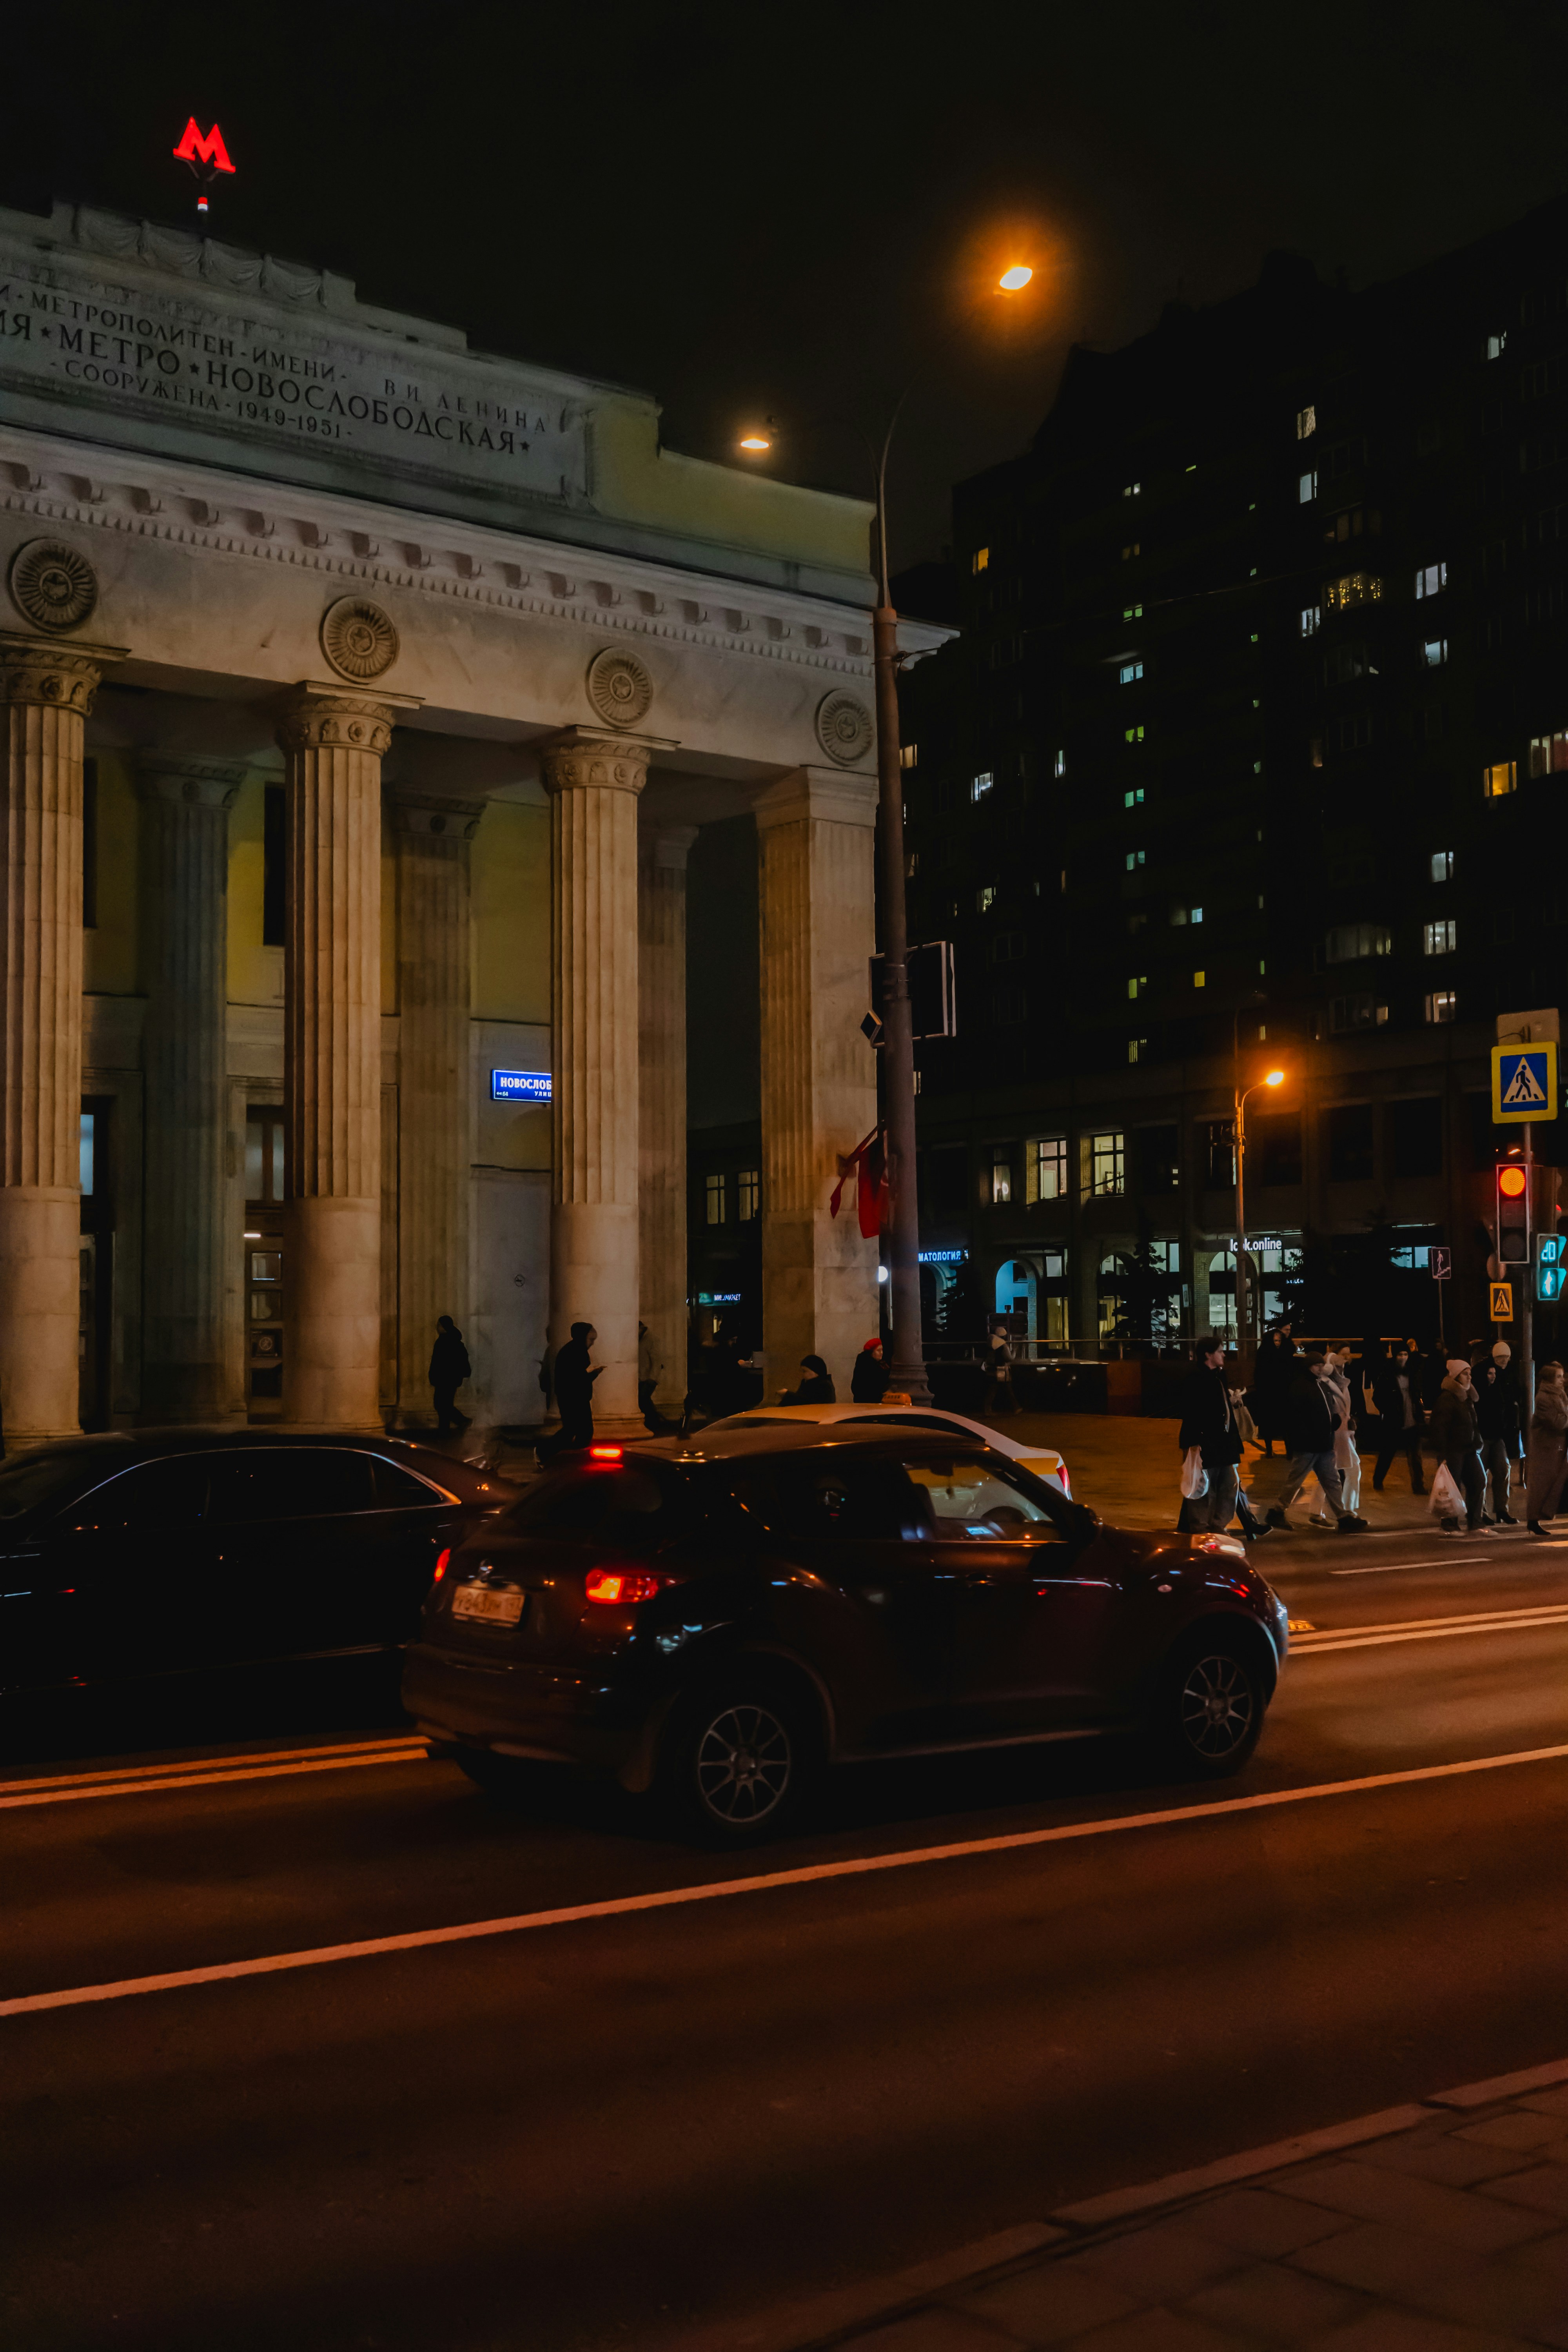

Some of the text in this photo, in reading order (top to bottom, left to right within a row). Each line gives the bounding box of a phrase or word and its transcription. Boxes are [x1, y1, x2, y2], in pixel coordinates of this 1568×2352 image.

[32, 290, 234, 358] МЕТРОПОЛИТЕН
[253, 347, 336, 382] ИМЕНИ
[437, 394, 546, 433] ЛЕНИНА
[59, 324, 180, 374] МЕТРО
[207, 360, 515, 455] НОВОСЛОБОДСКАЯ
[65, 359, 340, 438] СООРУЖЕНА 1949-1951
[501, 1077, 551, 1090] НОВОСЛОБ
[1230, 1237, 1282, 1252] lok.online
[1542, 1242, 1555, 1259] 20
